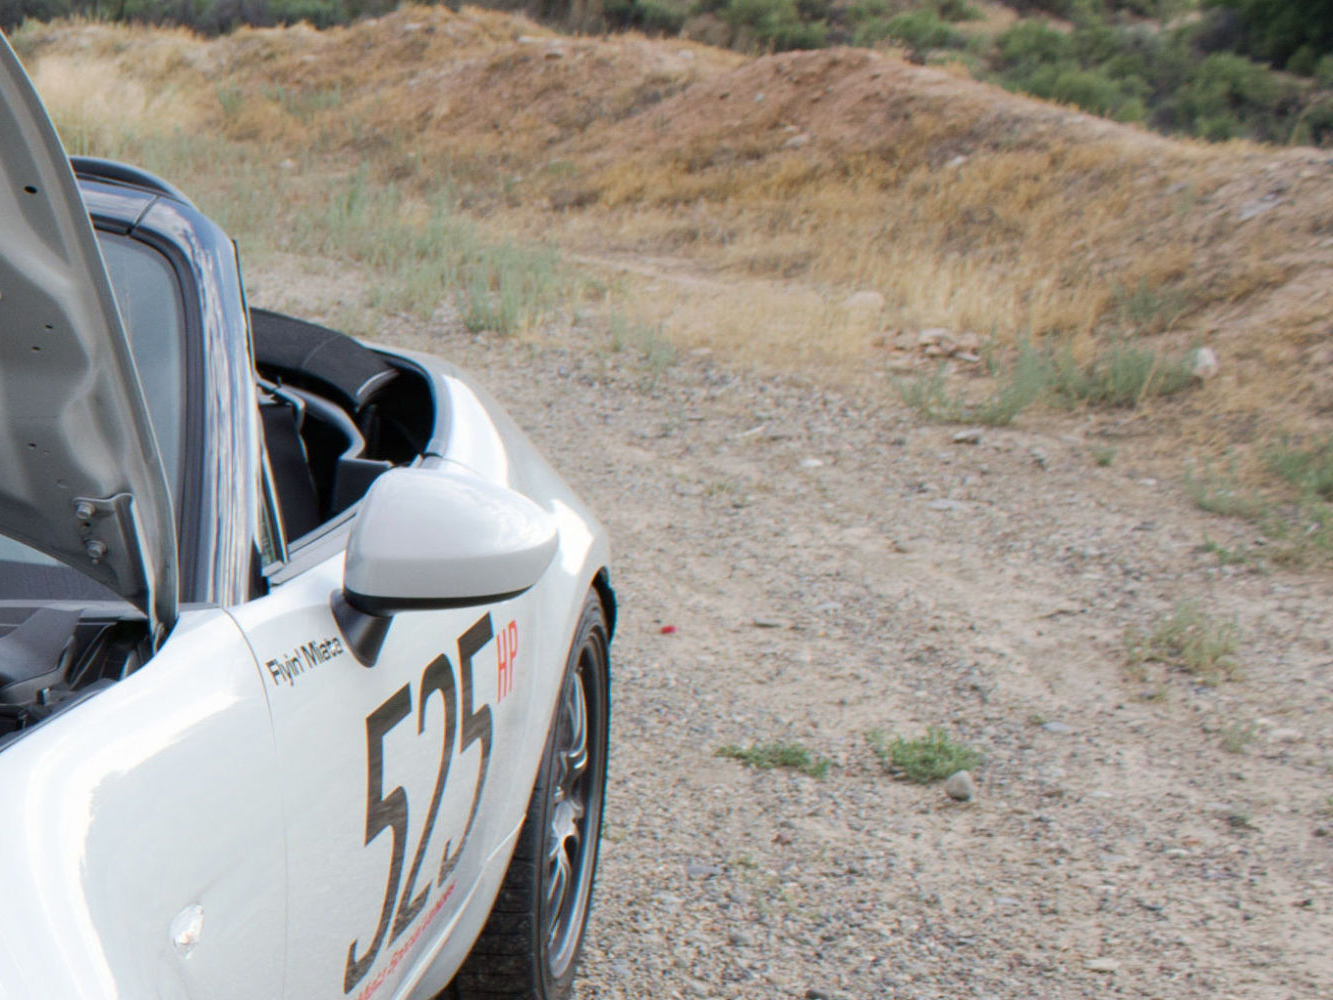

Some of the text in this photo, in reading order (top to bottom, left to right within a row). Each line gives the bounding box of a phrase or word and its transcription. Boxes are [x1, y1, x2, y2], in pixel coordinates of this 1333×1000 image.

[265, 637, 344, 687] Flyin' Miata
[344, 611, 518, 994] 525 HP
